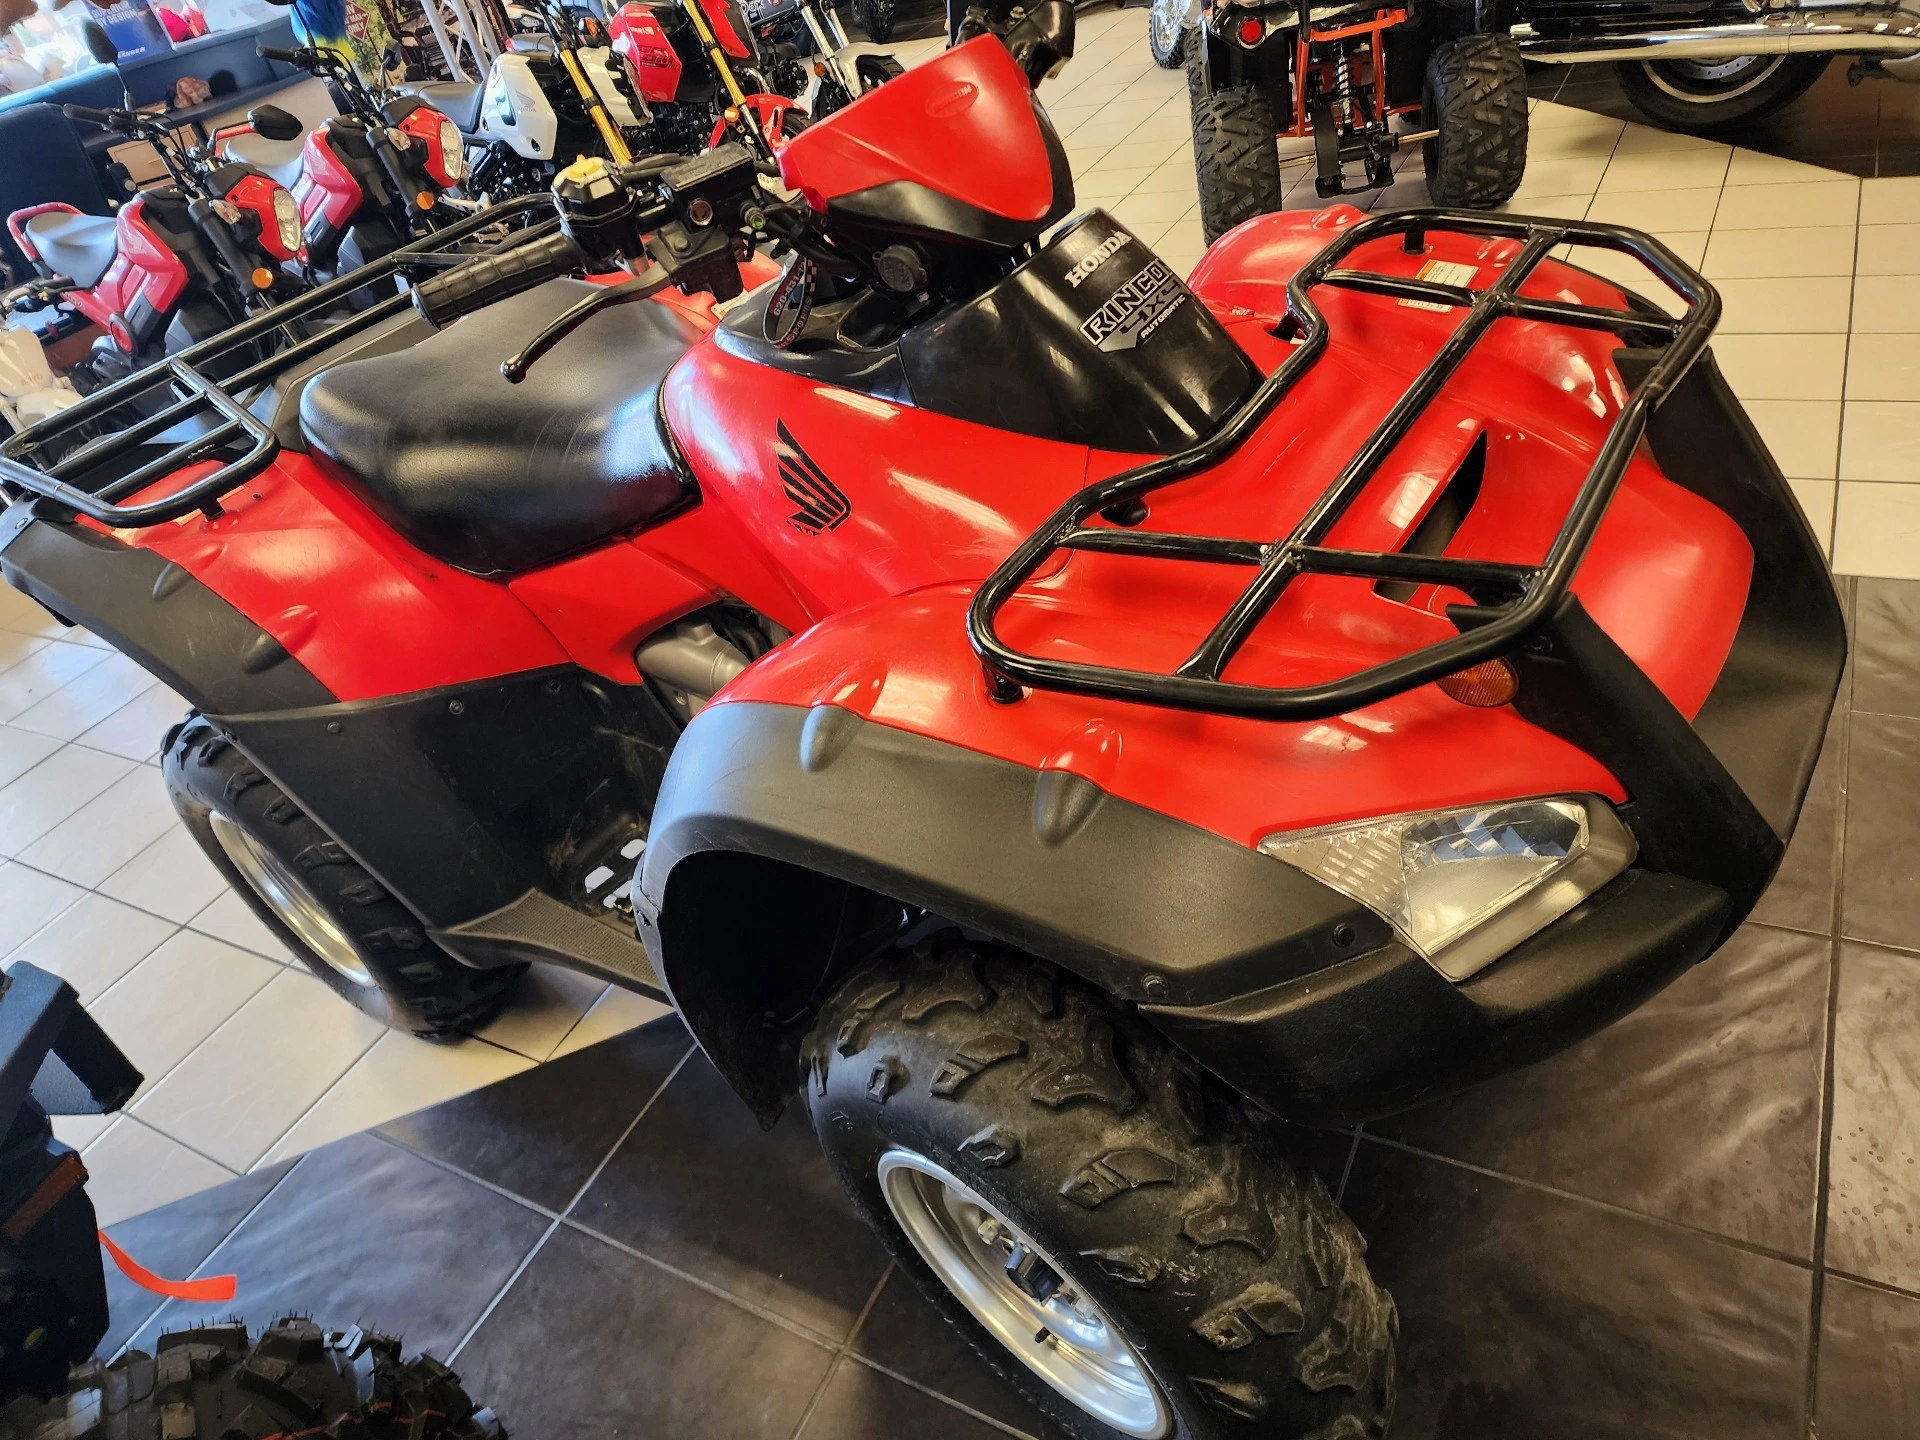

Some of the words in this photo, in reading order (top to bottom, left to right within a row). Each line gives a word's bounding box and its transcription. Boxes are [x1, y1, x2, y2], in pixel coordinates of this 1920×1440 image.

[106, 8, 138, 24] DESIGN
[1064, 230, 1132, 289] HONDA
[1079, 257, 1173, 346] RINCO
[1140, 293, 1186, 339] AUTOMATIC
